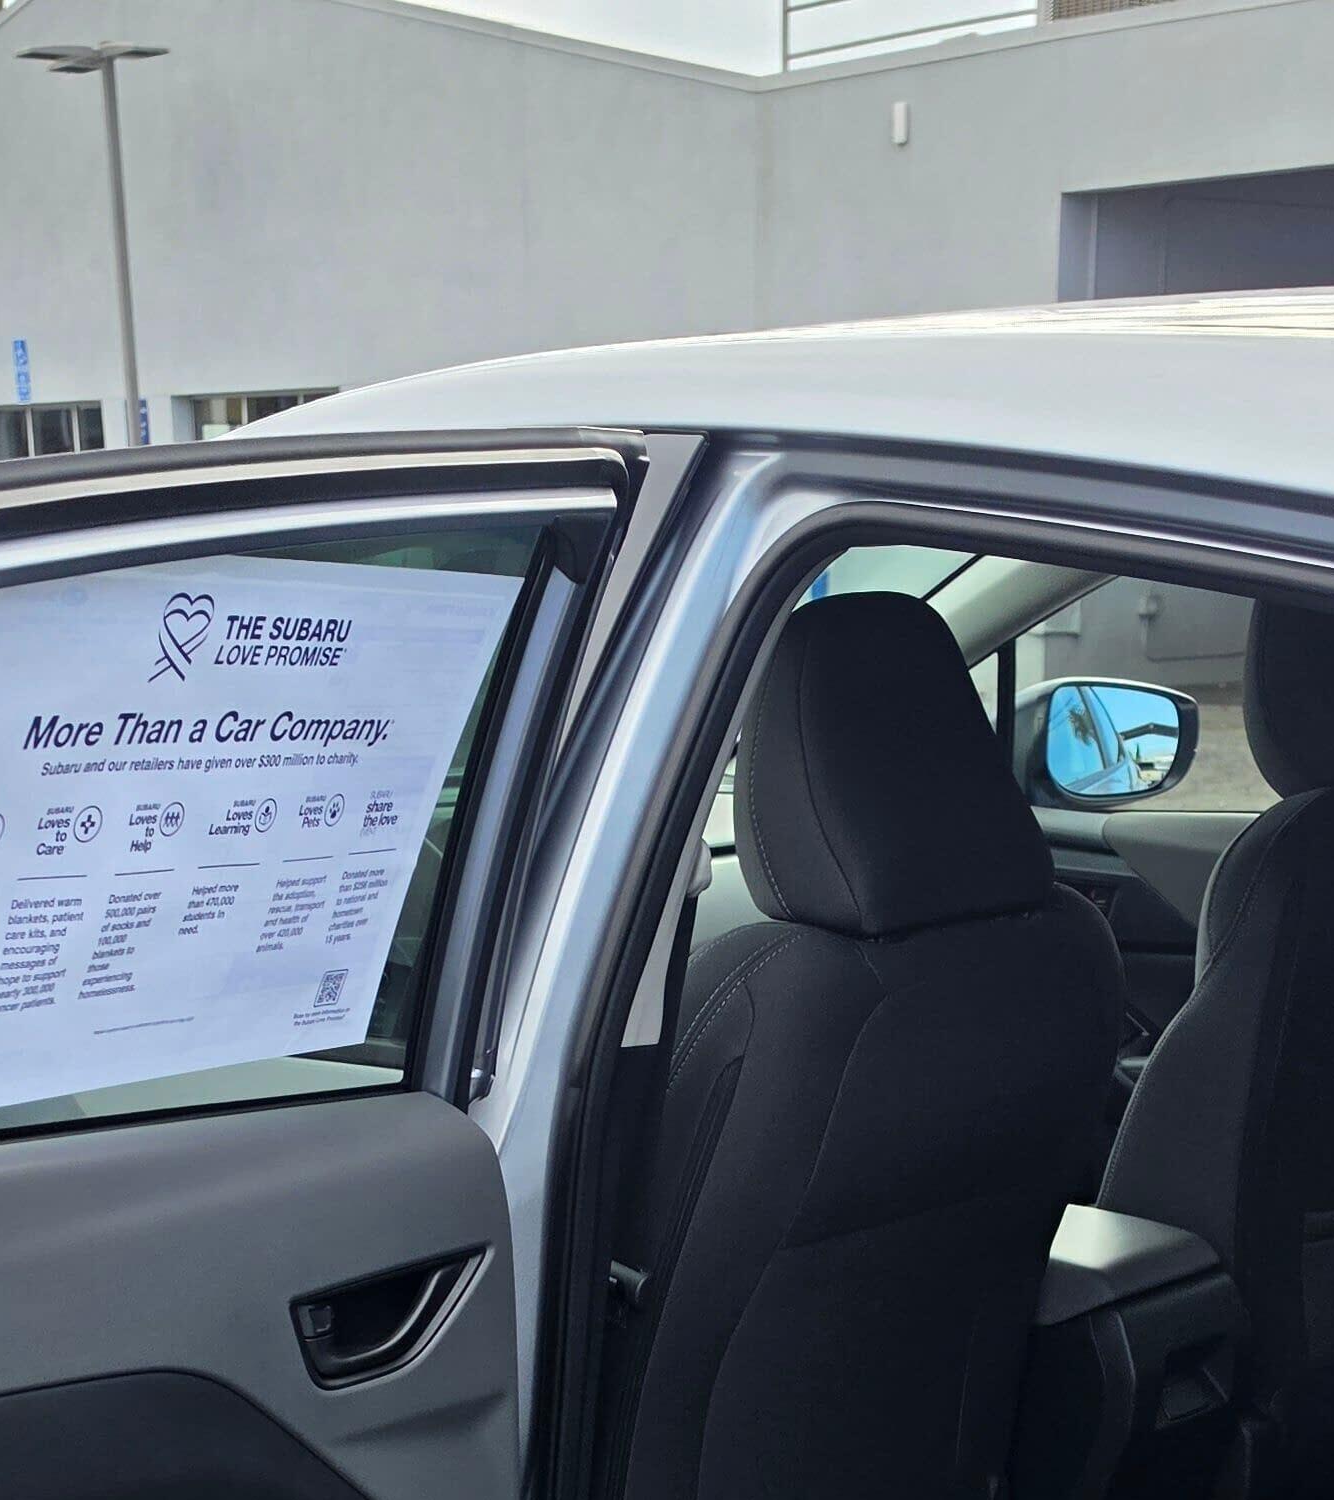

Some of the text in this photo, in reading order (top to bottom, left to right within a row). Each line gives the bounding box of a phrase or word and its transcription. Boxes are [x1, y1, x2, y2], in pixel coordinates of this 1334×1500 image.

[225, 614, 353, 643] THE SUBARU
[213, 645, 342, 667] LOVE PROMISE
[22, 710, 390, 751] More Than a Car Company.
[40, 760, 83, 777] Subaru
[83, 758, 105, 773] and
[107, 759, 127, 772] our
[128, 756, 175, 771] retailers
[177, 756, 202, 770] have
[203, 755, 233, 772] given
[233, 757, 257, 769] over
[257, 754, 282, 769] $300
[282, 753, 315, 768] million
[315, 753, 326, 765] to
[298, 804, 323, 817] Loves
[366, 800, 393, 814] share
[129, 813, 157, 826] Loves
[225, 808, 253, 822] Loves
[363, 813, 398, 827] the love
[37, 817, 71, 830] Loves
[302, 816, 320, 828] Pets
[55, 830, 67, 842] to
[145, 825, 154, 838] to
[208, 823, 250, 836] Learning
[36, 843, 65, 856] Care
[129, 840, 152, 853] Help
[11, 898, 83, 909] Delivered warm
